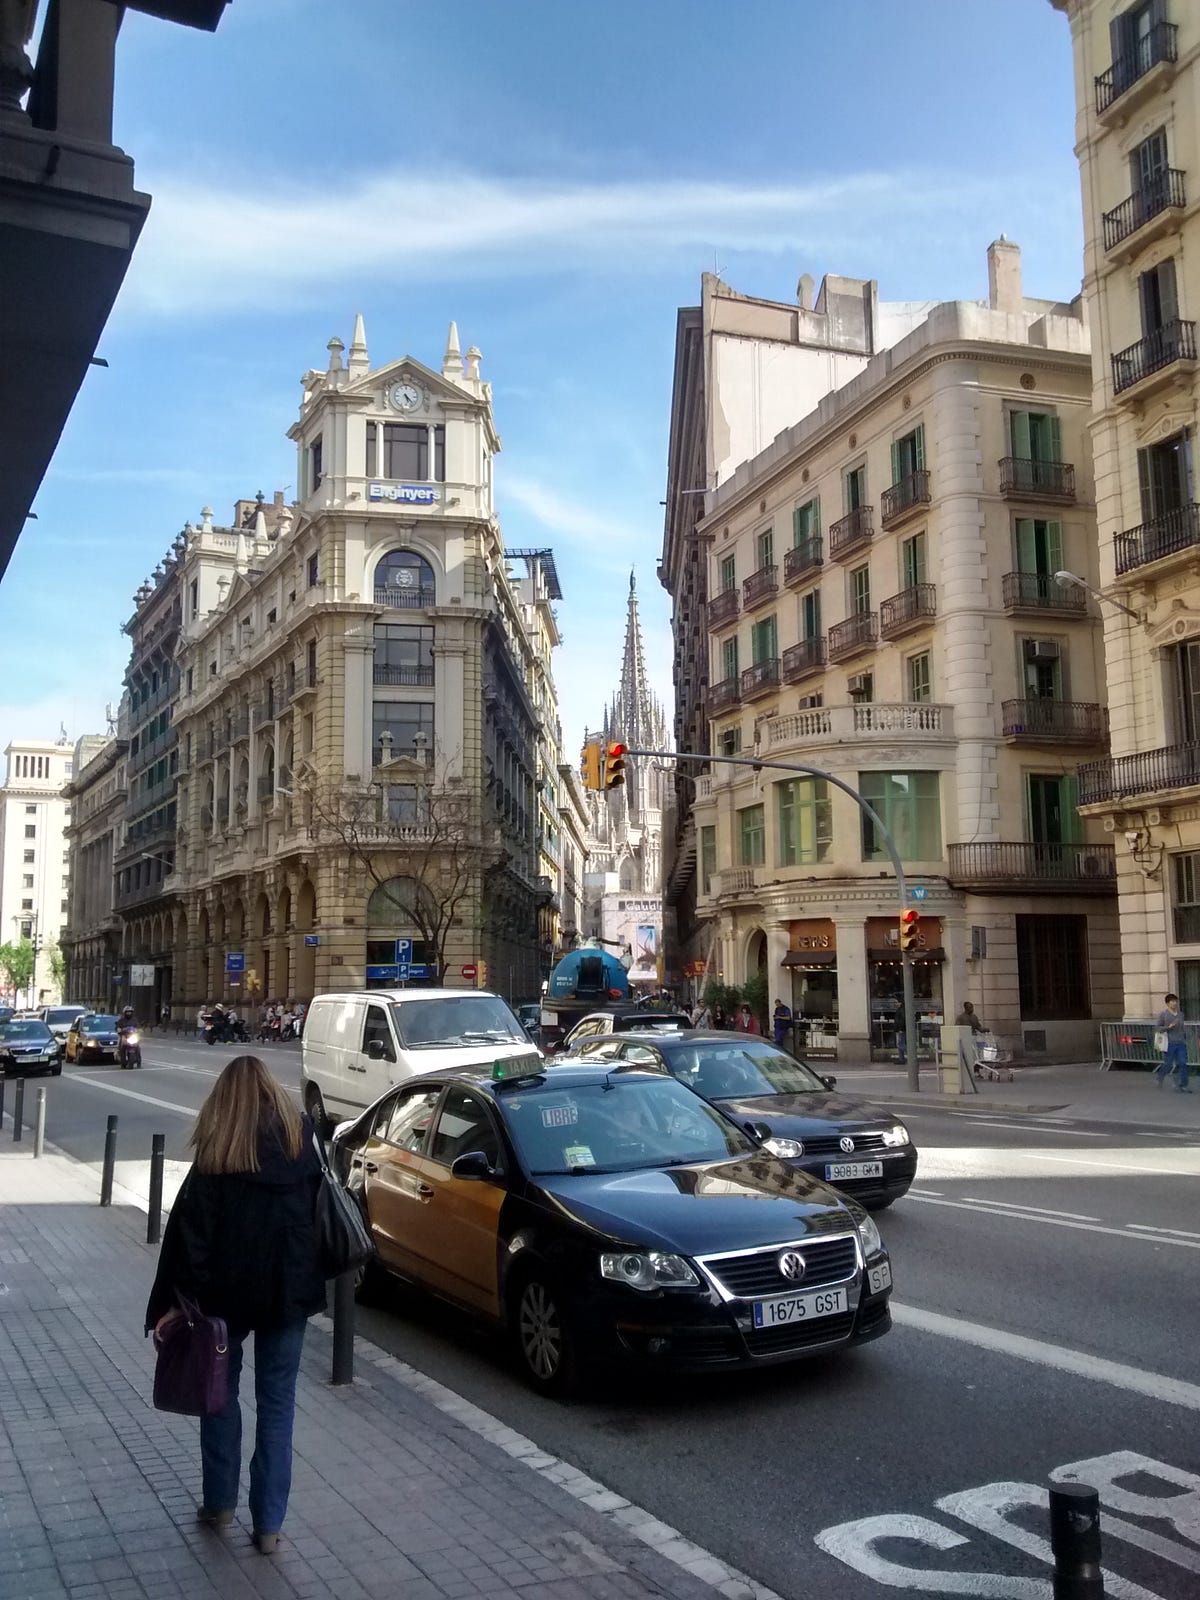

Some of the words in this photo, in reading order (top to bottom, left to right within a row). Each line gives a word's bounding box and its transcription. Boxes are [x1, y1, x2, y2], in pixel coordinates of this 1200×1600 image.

[370, 484, 441, 501] Enginyers
[399, 940, 409, 953] P
[508, 1059, 530, 1073] TAXI
[543, 1107, 578, 1127] LIBRE
[833, 1165, 858, 1178] 9083
[871, 1265, 889, 1290] SP
[769, 1298, 806, 1322] 1675
[815, 1291, 842, 1314] GST
